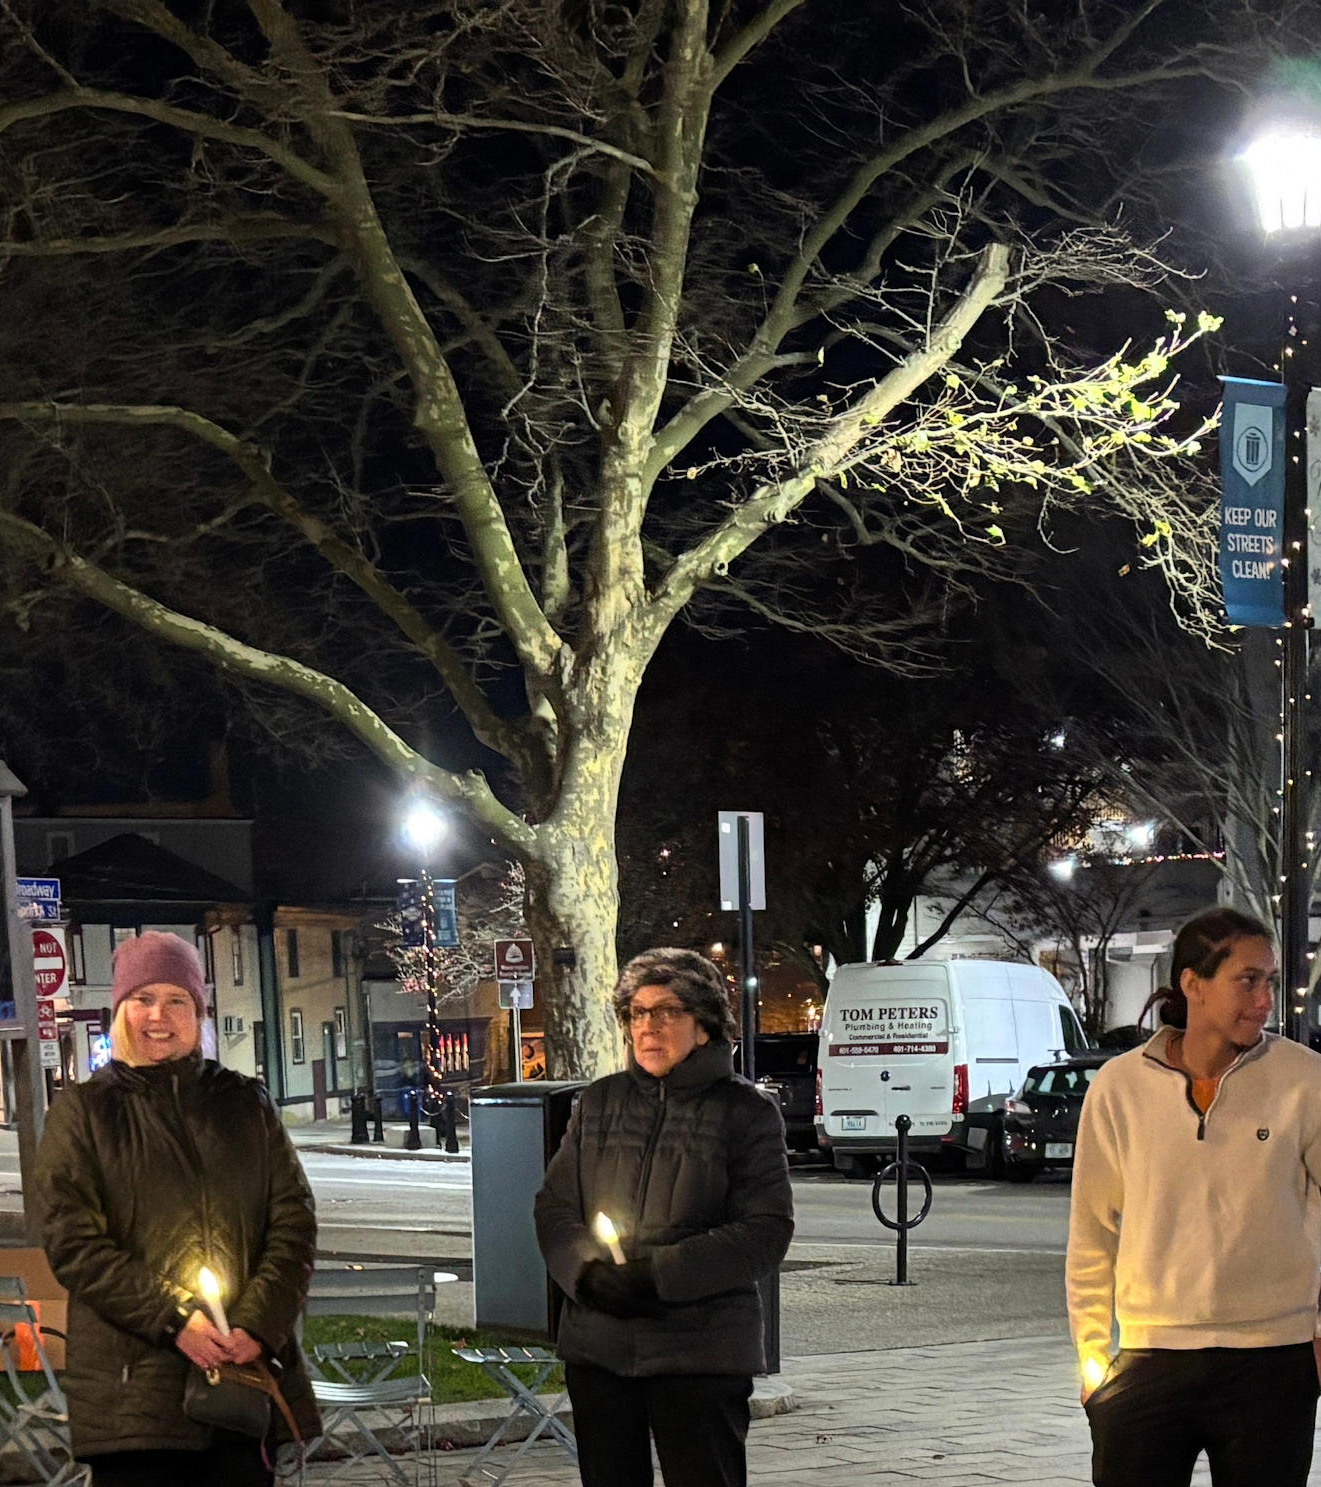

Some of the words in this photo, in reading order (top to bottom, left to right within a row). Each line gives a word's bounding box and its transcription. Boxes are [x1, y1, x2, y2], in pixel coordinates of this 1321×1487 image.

[1225, 507, 1251, 526] KEEP
[1254, 508, 1277, 528] OUR
[1227, 533, 1274, 555] STREETS
[1232, 560, 1270, 580] CLEAN!
[17, 882, 55, 898] roadway
[39, 942, 57, 953] NOT
[35, 973, 57, 983] NTER
[840, 1009, 874, 1021] TOM
[879, 1006, 938, 1020] PETERS
[845, 1023, 885, 1032] Plumbing
[889, 1022, 894, 1030] &
[898, 1021, 932, 1031] Heating
[893, 1032, 928, 1040] Residential
